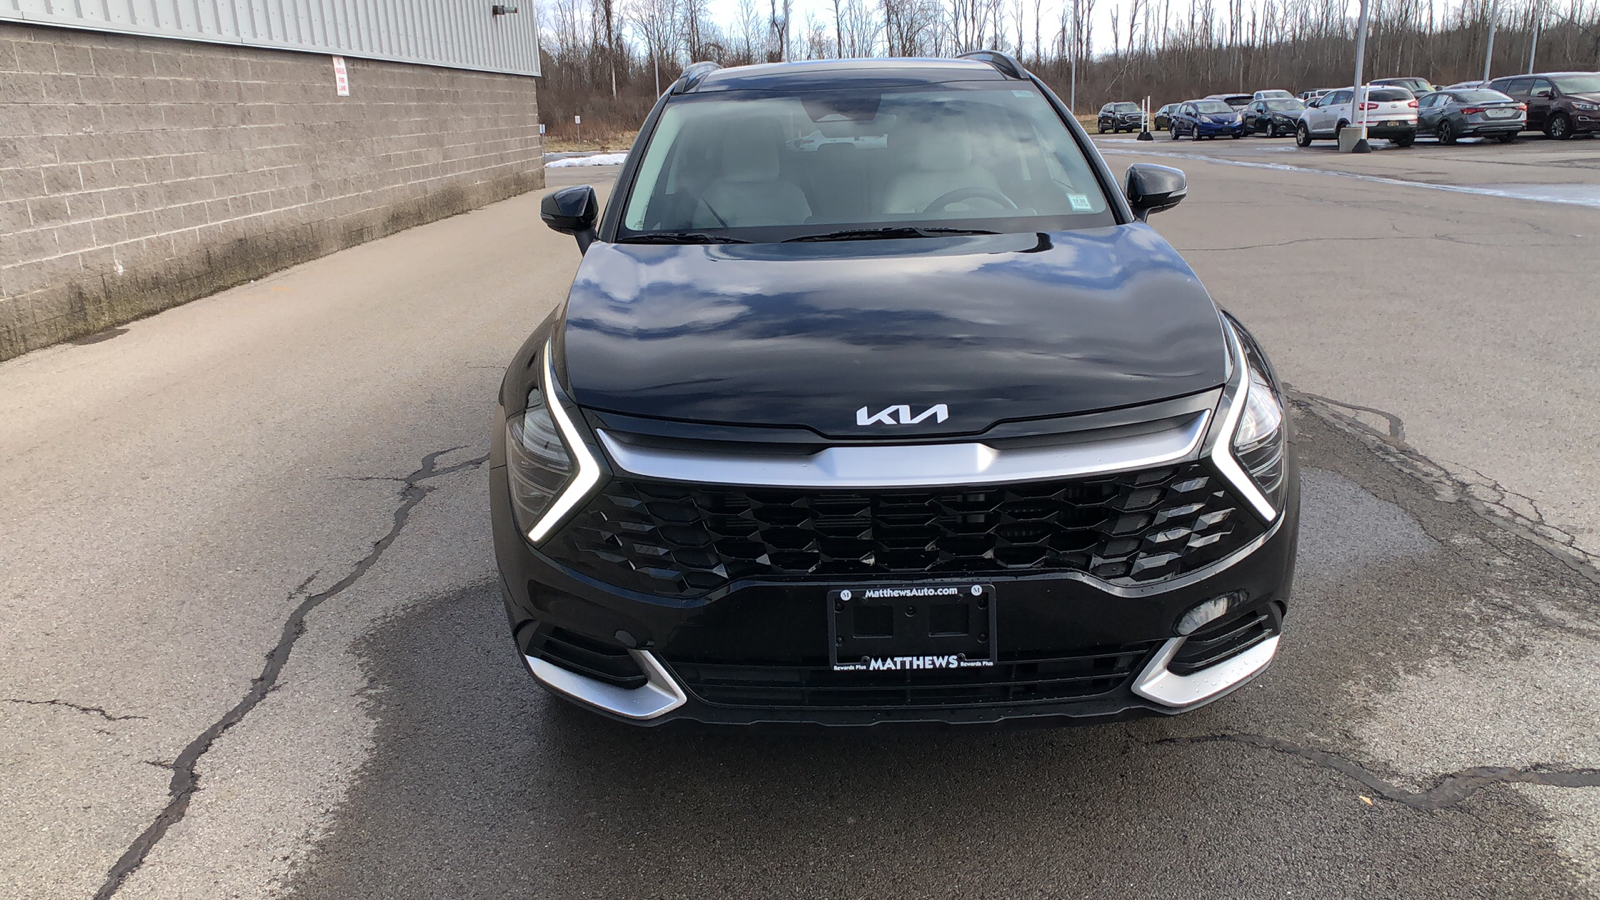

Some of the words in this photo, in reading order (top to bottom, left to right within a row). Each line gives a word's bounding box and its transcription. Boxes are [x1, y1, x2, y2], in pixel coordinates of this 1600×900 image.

[856, 403, 949, 426] KIA
[865, 587, 958, 598] MatthewsAuto.com
[869, 655, 958, 671] MATTHEWS
